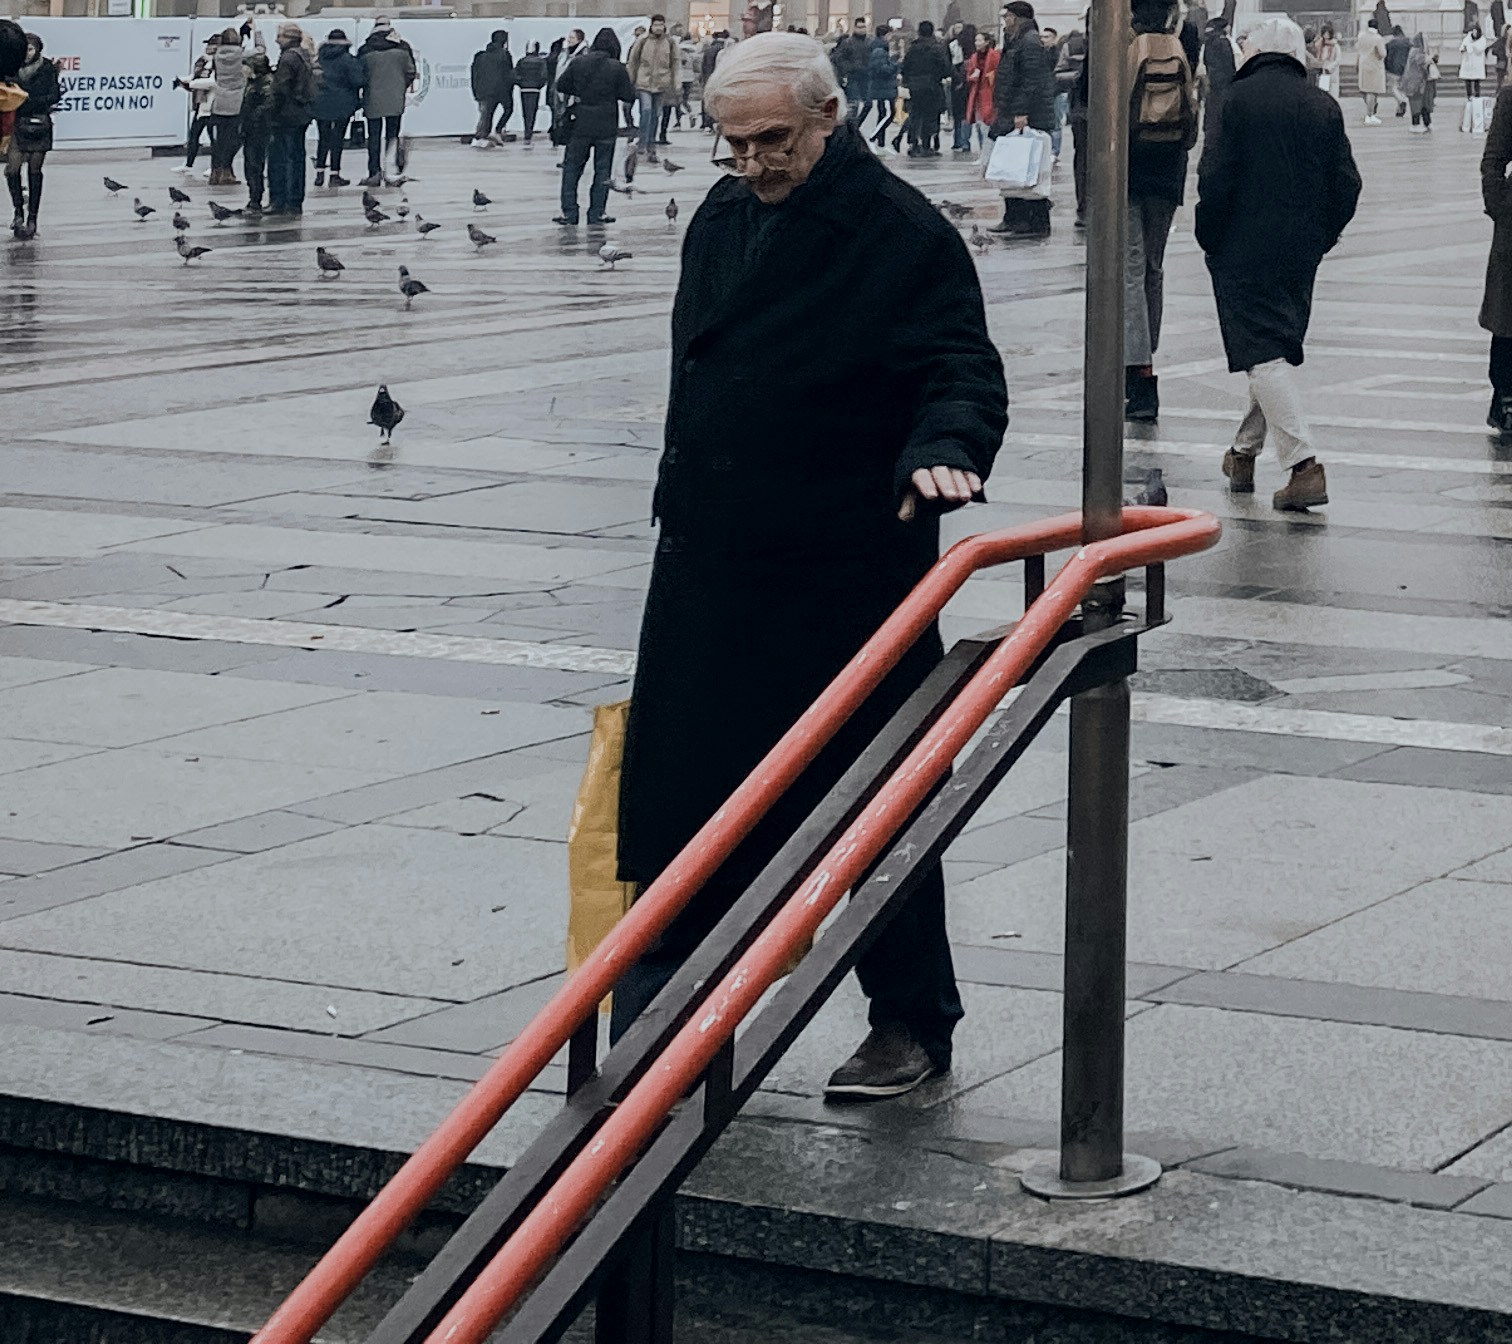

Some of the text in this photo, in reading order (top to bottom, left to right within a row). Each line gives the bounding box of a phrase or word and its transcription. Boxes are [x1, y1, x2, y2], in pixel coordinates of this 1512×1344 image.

[100, 75, 163, 90] PASSATO
[56, 95, 154, 112] ESTE CON NOI
